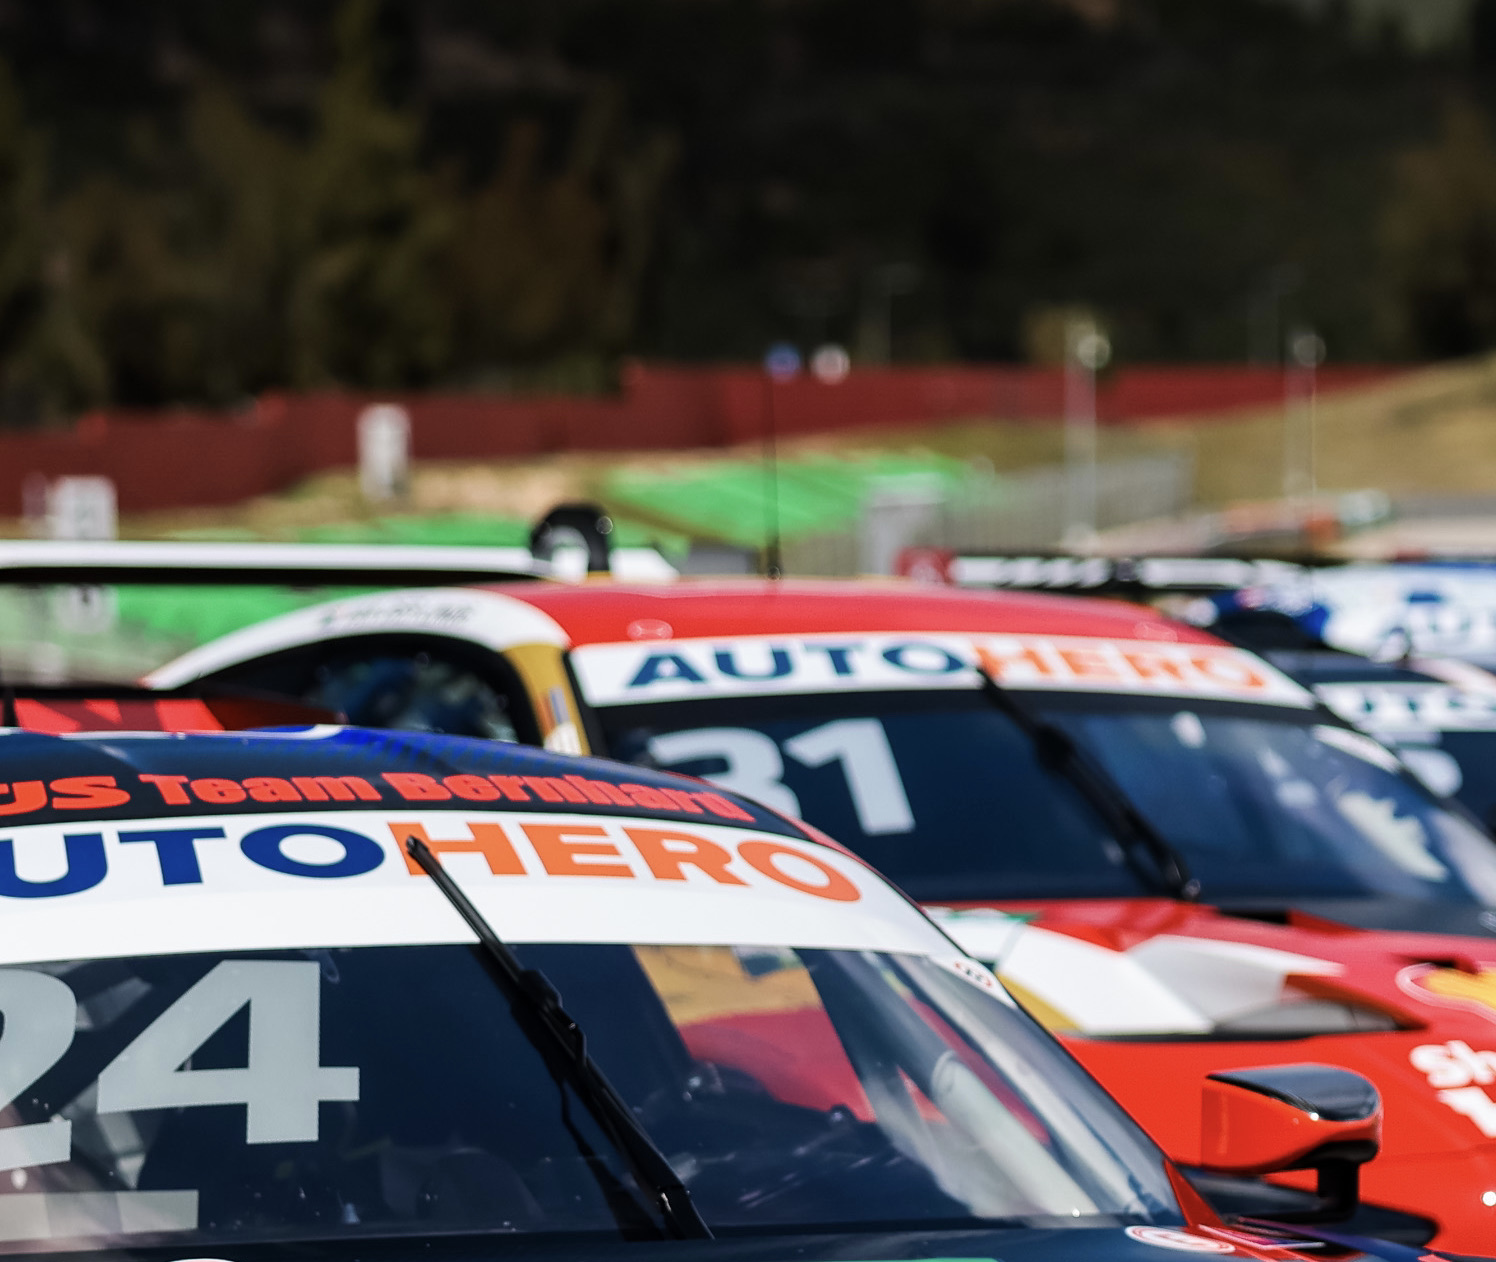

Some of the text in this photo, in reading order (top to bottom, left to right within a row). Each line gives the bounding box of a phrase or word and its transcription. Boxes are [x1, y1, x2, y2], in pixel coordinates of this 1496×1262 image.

[626, 638, 1266, 690] AUTOHERO
[138, 773, 382, 805] Team
[380, 772, 756, 823] Bernhard
[646, 717, 916, 836] 31
